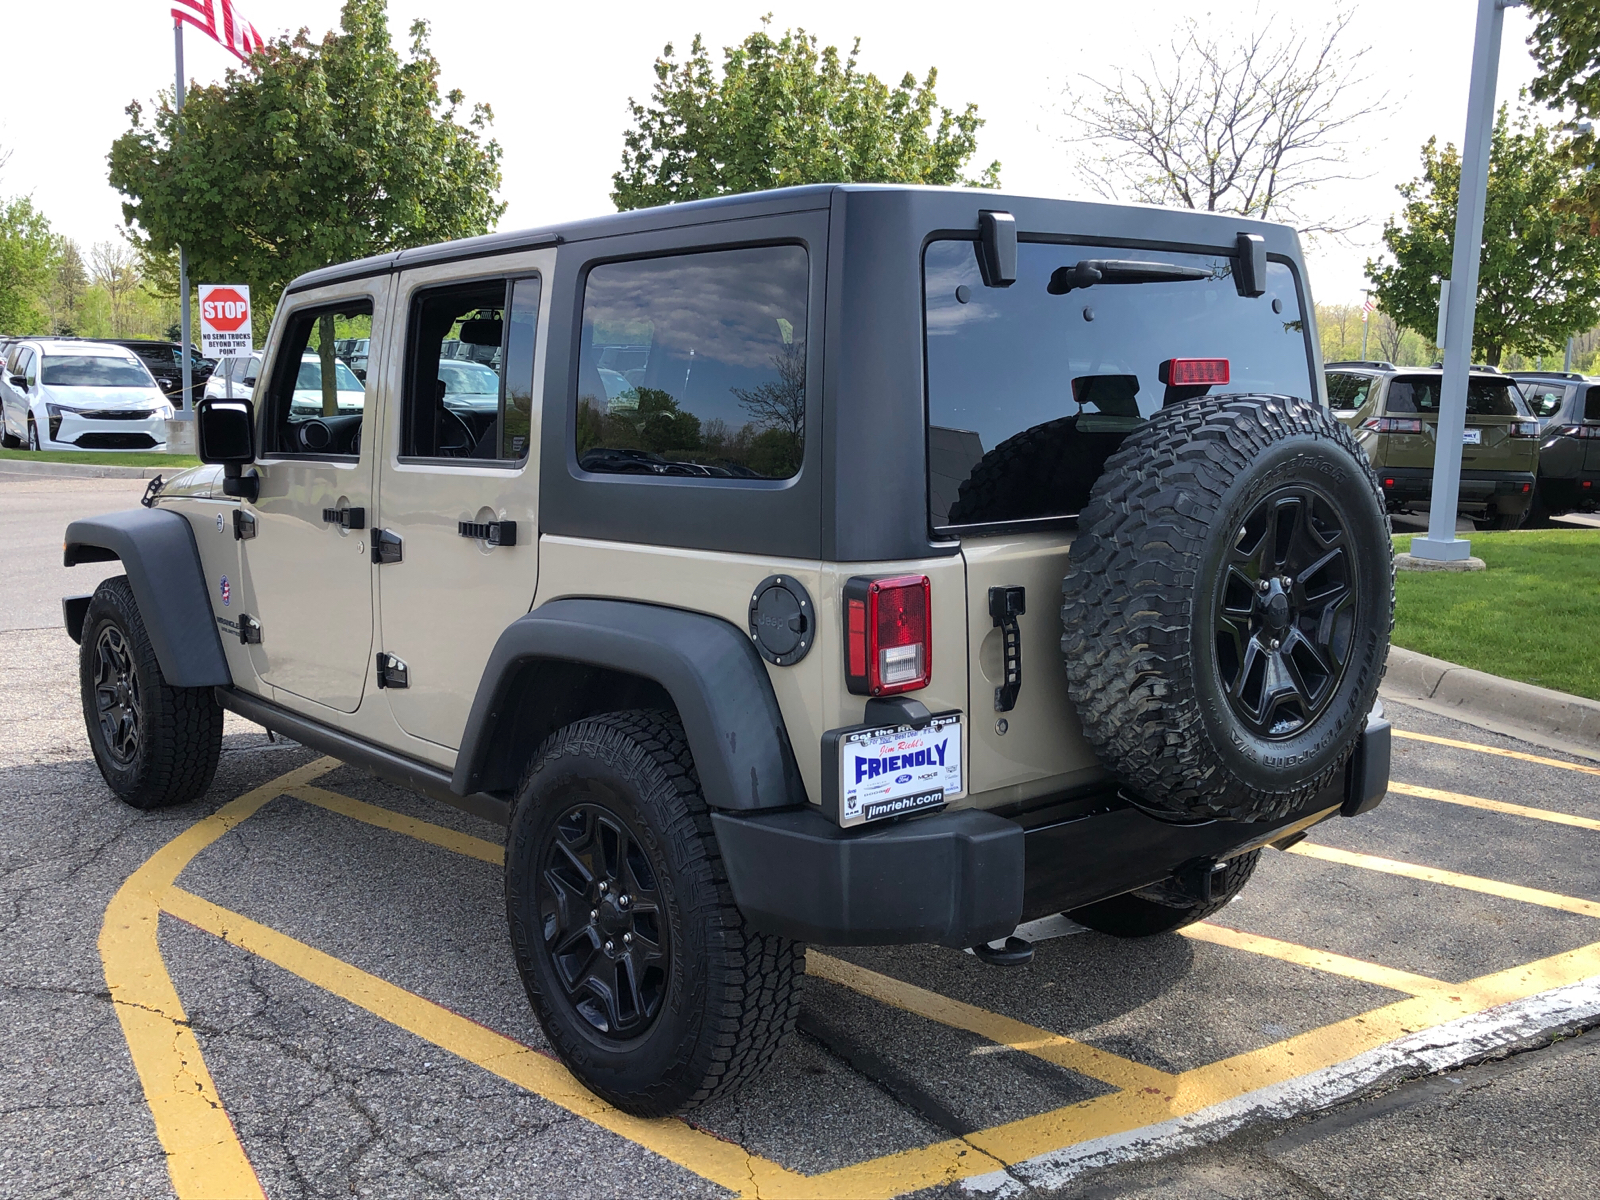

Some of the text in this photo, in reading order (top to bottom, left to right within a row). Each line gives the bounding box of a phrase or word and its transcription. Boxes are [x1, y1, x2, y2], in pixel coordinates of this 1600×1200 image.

[204, 301, 246, 319] STOP
[208, 340, 231, 348] BEYOND
[757, 613, 784, 630] Jeep
[930, 716, 957, 726] Deal
[850, 733, 872, 742] Got
[874, 729, 894, 737] the
[879, 738, 924, 757] Jim Riehl's
[855, 737, 948, 785] FRIENDLY
[918, 771, 938, 780] MOKE
[867, 792, 942, 819] jimriehl.com
[634, 804, 684, 1016] YOKOHAMA
